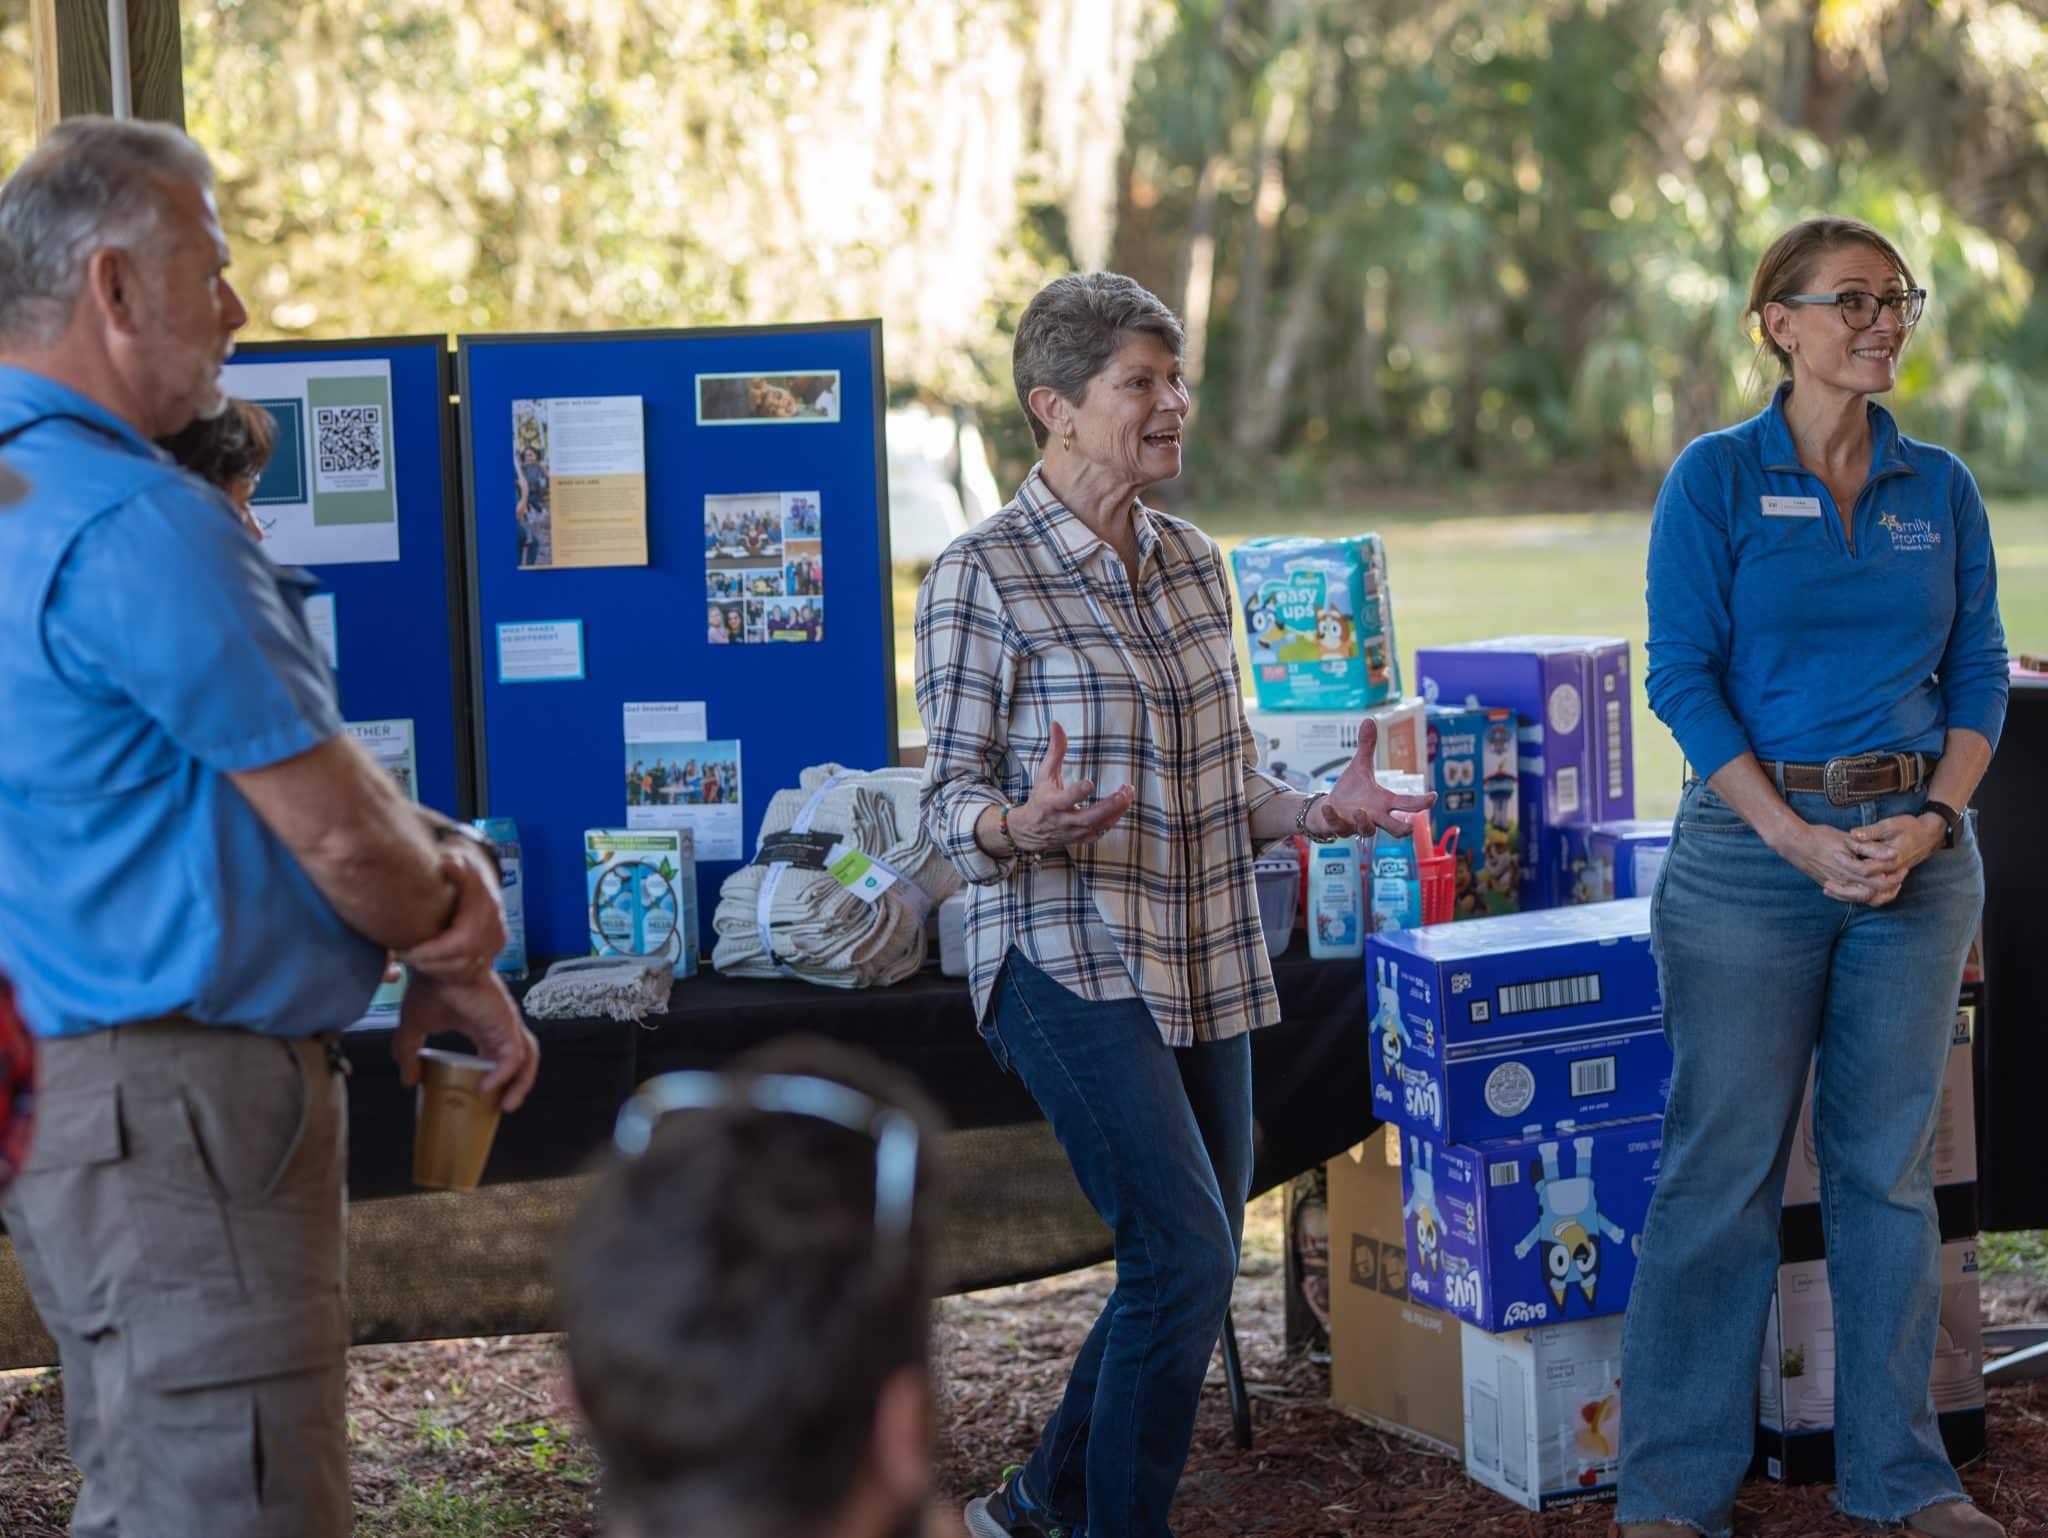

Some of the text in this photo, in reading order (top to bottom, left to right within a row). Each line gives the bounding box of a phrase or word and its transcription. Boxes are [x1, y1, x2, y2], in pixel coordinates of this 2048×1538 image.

[1888, 515, 1931, 533] Family
[1890, 530, 1941, 544] Promise
[1276, 588, 1317, 606] easy
[1282, 604, 1315, 621] ups
[1963, 1250, 1976, 1263] 12
